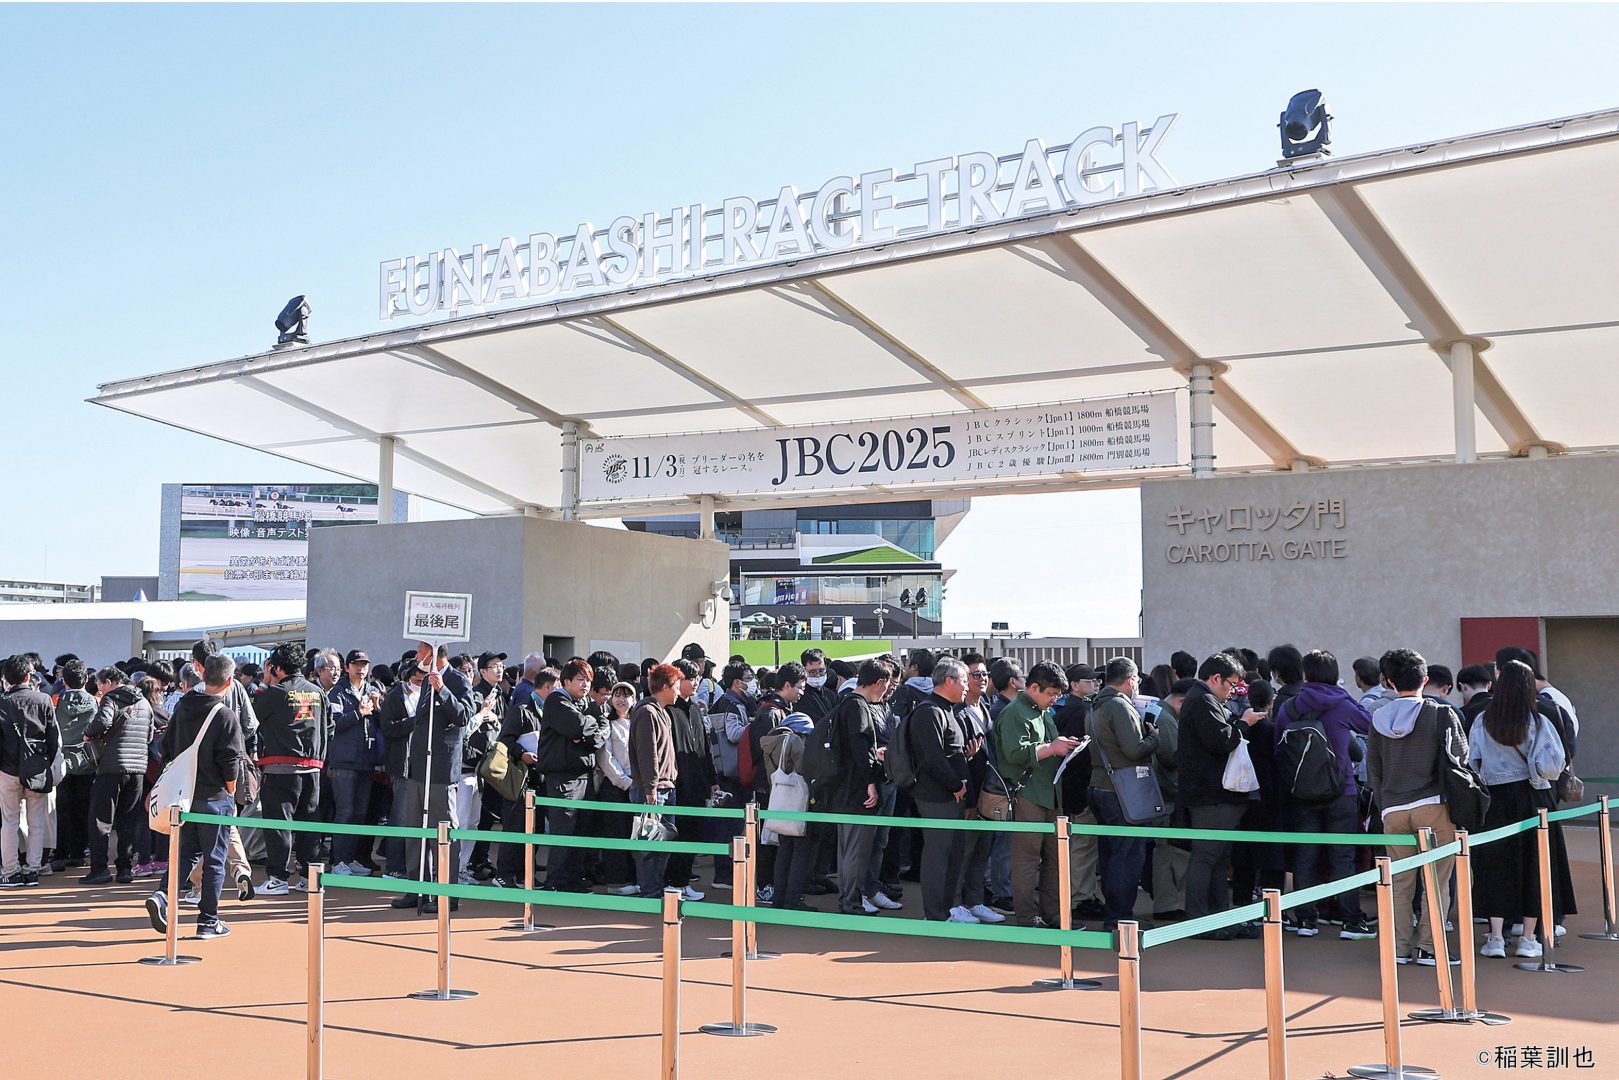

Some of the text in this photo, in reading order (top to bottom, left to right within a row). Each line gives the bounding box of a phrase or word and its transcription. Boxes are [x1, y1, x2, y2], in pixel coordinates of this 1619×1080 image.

[379, 111, 1182, 321] FUNABASHI RACE TRACK
[1077, 410, 1102, 420] 1800m
[1105, 404, 1149, 417] 船橋競馬場
[1078, 424, 1104, 434] 1000m
[1106, 419, 1150, 432] 船橋競馬場
[1080, 439, 1104, 449] 1800m
[1107, 433, 1151, 446] 船橋競馬場
[692, 452, 764, 464] ブリーダーの名を
[771, 426, 956, 485] JBC2025
[1079, 452, 1104, 462] 1800m
[1107, 447, 1151, 460] 門別競馬場
[632, 454, 677, 478] 11/3
[1166, 498, 1346, 535] キャロッタ門
[1166, 538, 1348, 563] CAROTTA GATE
[414, 613, 459, 629] 最後尾
